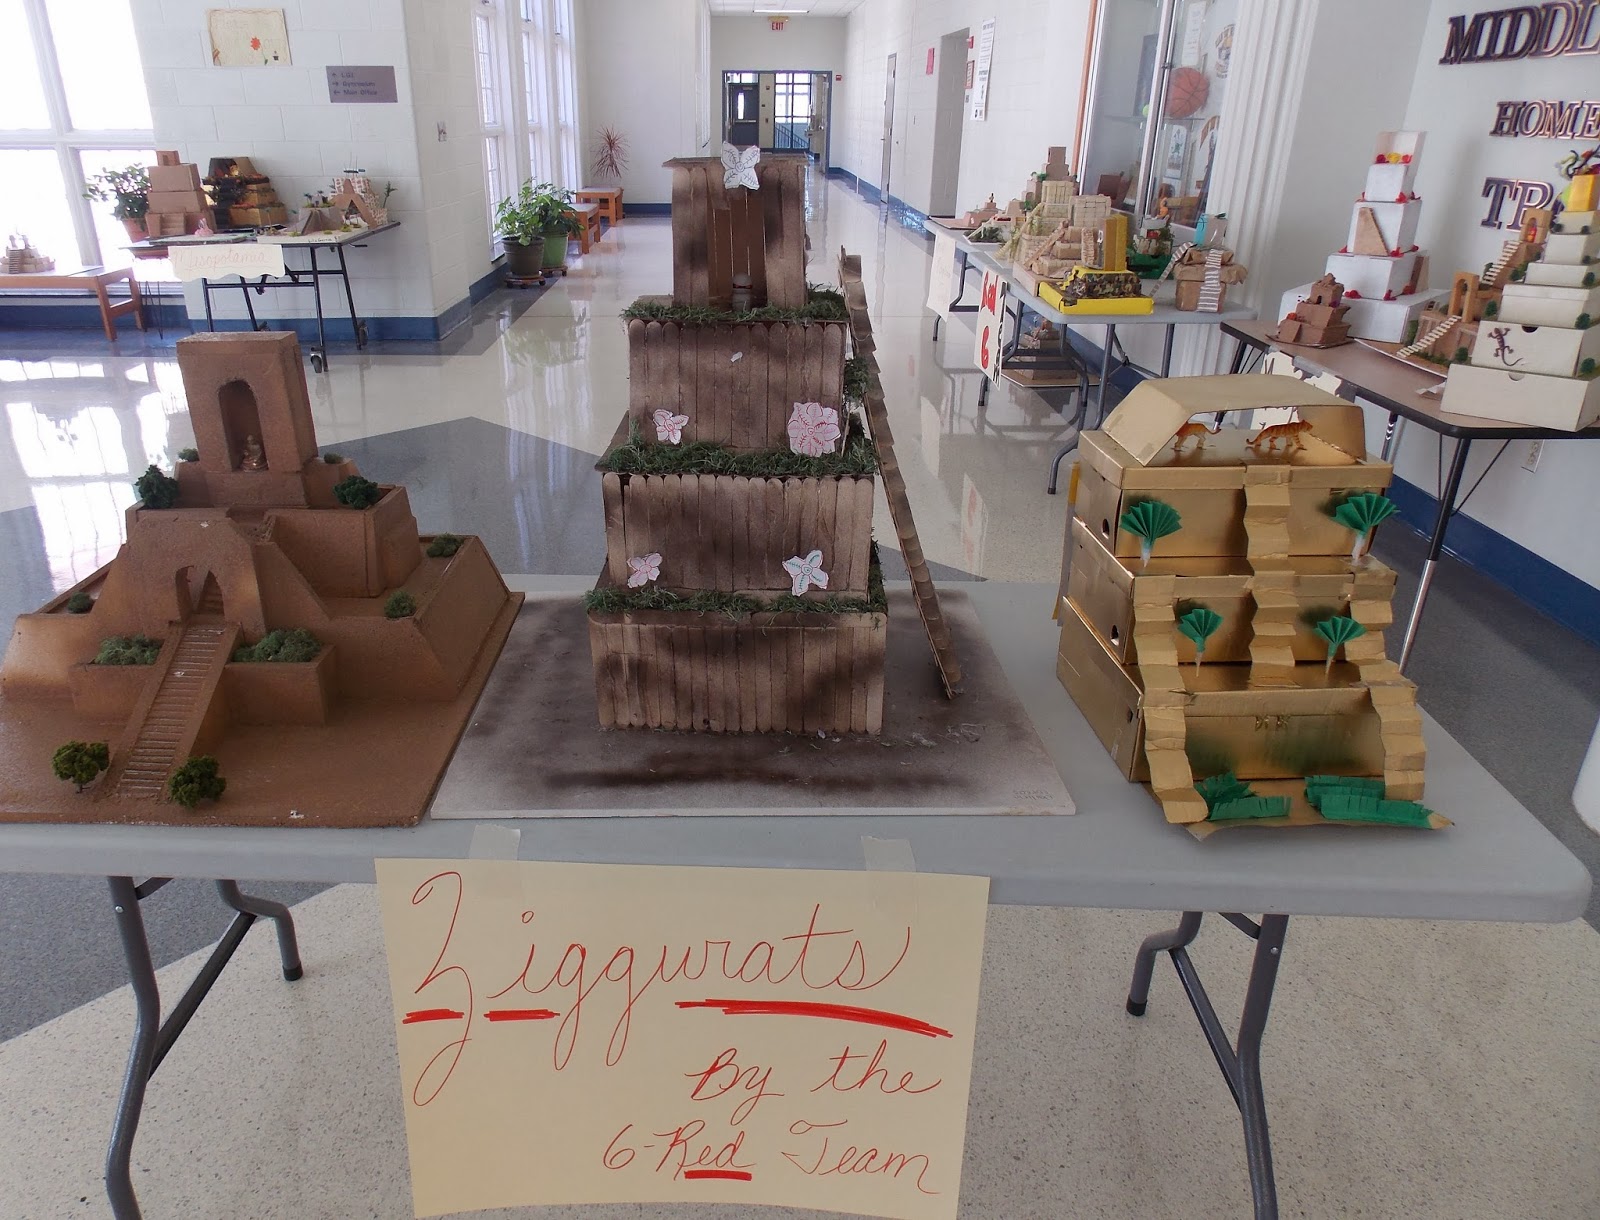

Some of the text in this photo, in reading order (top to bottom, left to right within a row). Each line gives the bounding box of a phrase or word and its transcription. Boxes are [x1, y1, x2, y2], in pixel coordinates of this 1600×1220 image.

[772, 22, 784, 30] EXIT
[1489, 99, 1600, 140] HOME
[981, 325, 990, 369] 6
[411, 871, 912, 1107] Ziggurats
[684, 1039, 944, 1126] By the
[780, 1119, 941, 1195] Team
